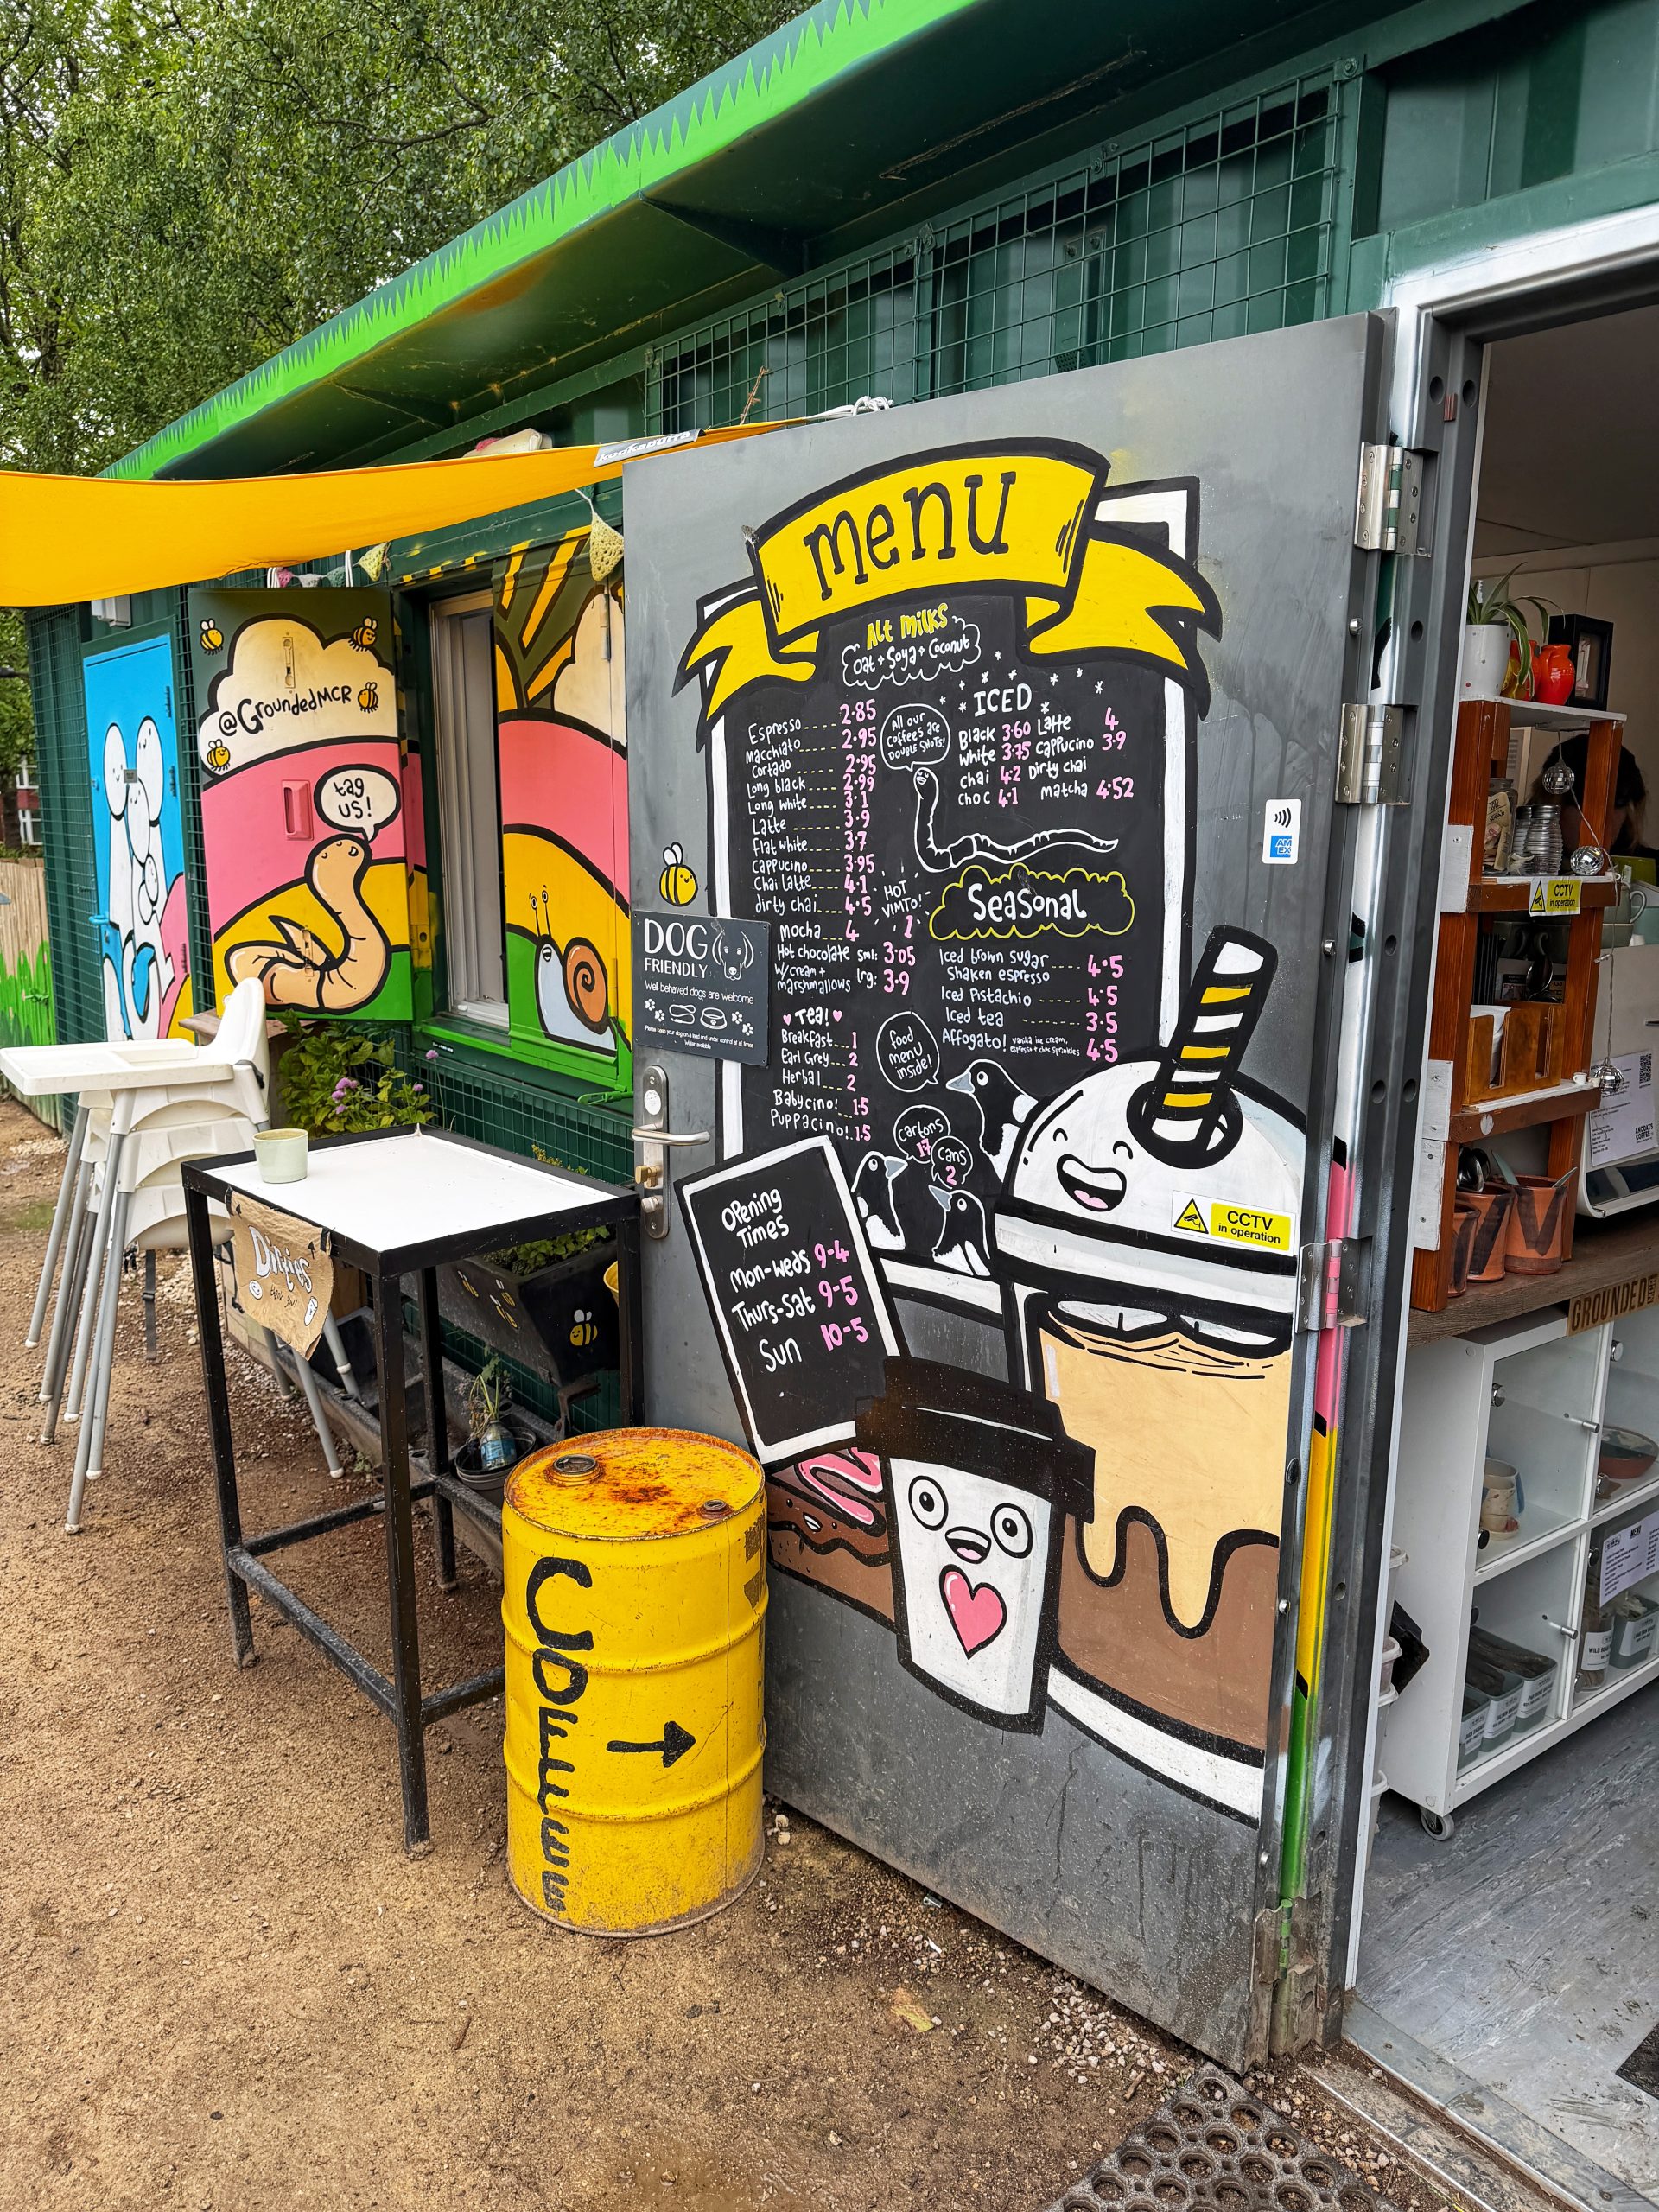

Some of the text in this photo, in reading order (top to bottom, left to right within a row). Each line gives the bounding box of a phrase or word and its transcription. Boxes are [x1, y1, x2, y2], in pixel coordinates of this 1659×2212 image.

[867, 620, 893, 650] Alt
[887, 646, 917, 671] Soya
[929, 634, 970, 658] Coconut
[219, 685, 352, 736] @GroundedMCR
[974, 683, 1032, 717] ICED
[748, 719, 801, 745] Espresso
[892, 713, 925, 731] All our
[927, 722, 940, 735] are
[959, 727, 995, 750] Black
[1038, 714, 1071, 735] Latte
[1105, 707, 1119, 730] 4
[888, 743, 917, 760] DOUBLE
[1029, 762, 1059, 779] Dirty
[333, 778, 365, 798] tag
[747, 782, 769, 799] Long
[775, 777, 805, 793] black
[748, 801, 773, 817] Long
[753, 819, 786, 836] Latte
[884, 880, 906, 899] HOT
[1554, 884, 1573, 896] CCTV
[755, 894, 785, 916] dirty
[1555, 899, 1575, 908] operation
[845, 920, 859, 941] 4
[904, 915, 913, 938] 1
[645, 918, 708, 960] DOG
[778, 944, 794, 961] Hot
[798, 944, 850, 963] chocolate
[939, 948, 963, 965] Iced
[971, 948, 1003, 964] brown
[645, 957, 708, 978] FRIENDLY
[999, 970, 1050, 985] espresso
[645, 980, 753, 1004] Well behaved dogs are welcome
[778, 978, 850, 995] marshmallows
[941, 986, 963, 1001] Iced
[946, 1007, 970, 1024] Iced
[978, 1008, 1003, 1027] tea
[782, 1029, 856, 1049] Breakfast 1
[889, 1026, 913, 1049] food
[943, 1028, 1007, 1052] Affogato!
[782, 1049, 858, 1067] Earl Grey 2
[897, 1054, 932, 1079] inside!
[783, 1069, 855, 1091] Herbal 2
[1636, 1130, 1650, 1141] COFFEE
[945, 1165, 957, 1185] 2
[1227, 1211, 1273, 1230] CCTV
[736, 1215, 789, 1248] Times
[1218, 1224, 1281, 1244] in operation
[814, 1240, 849, 1268] 9-4
[819, 1275, 858, 1308] 9-5
[1572, 1278, 1647, 1331] GROUNDED
[760, 1317, 868, 1372] Sun 10-5
[525, 1557, 594, 1913] COFFEE
